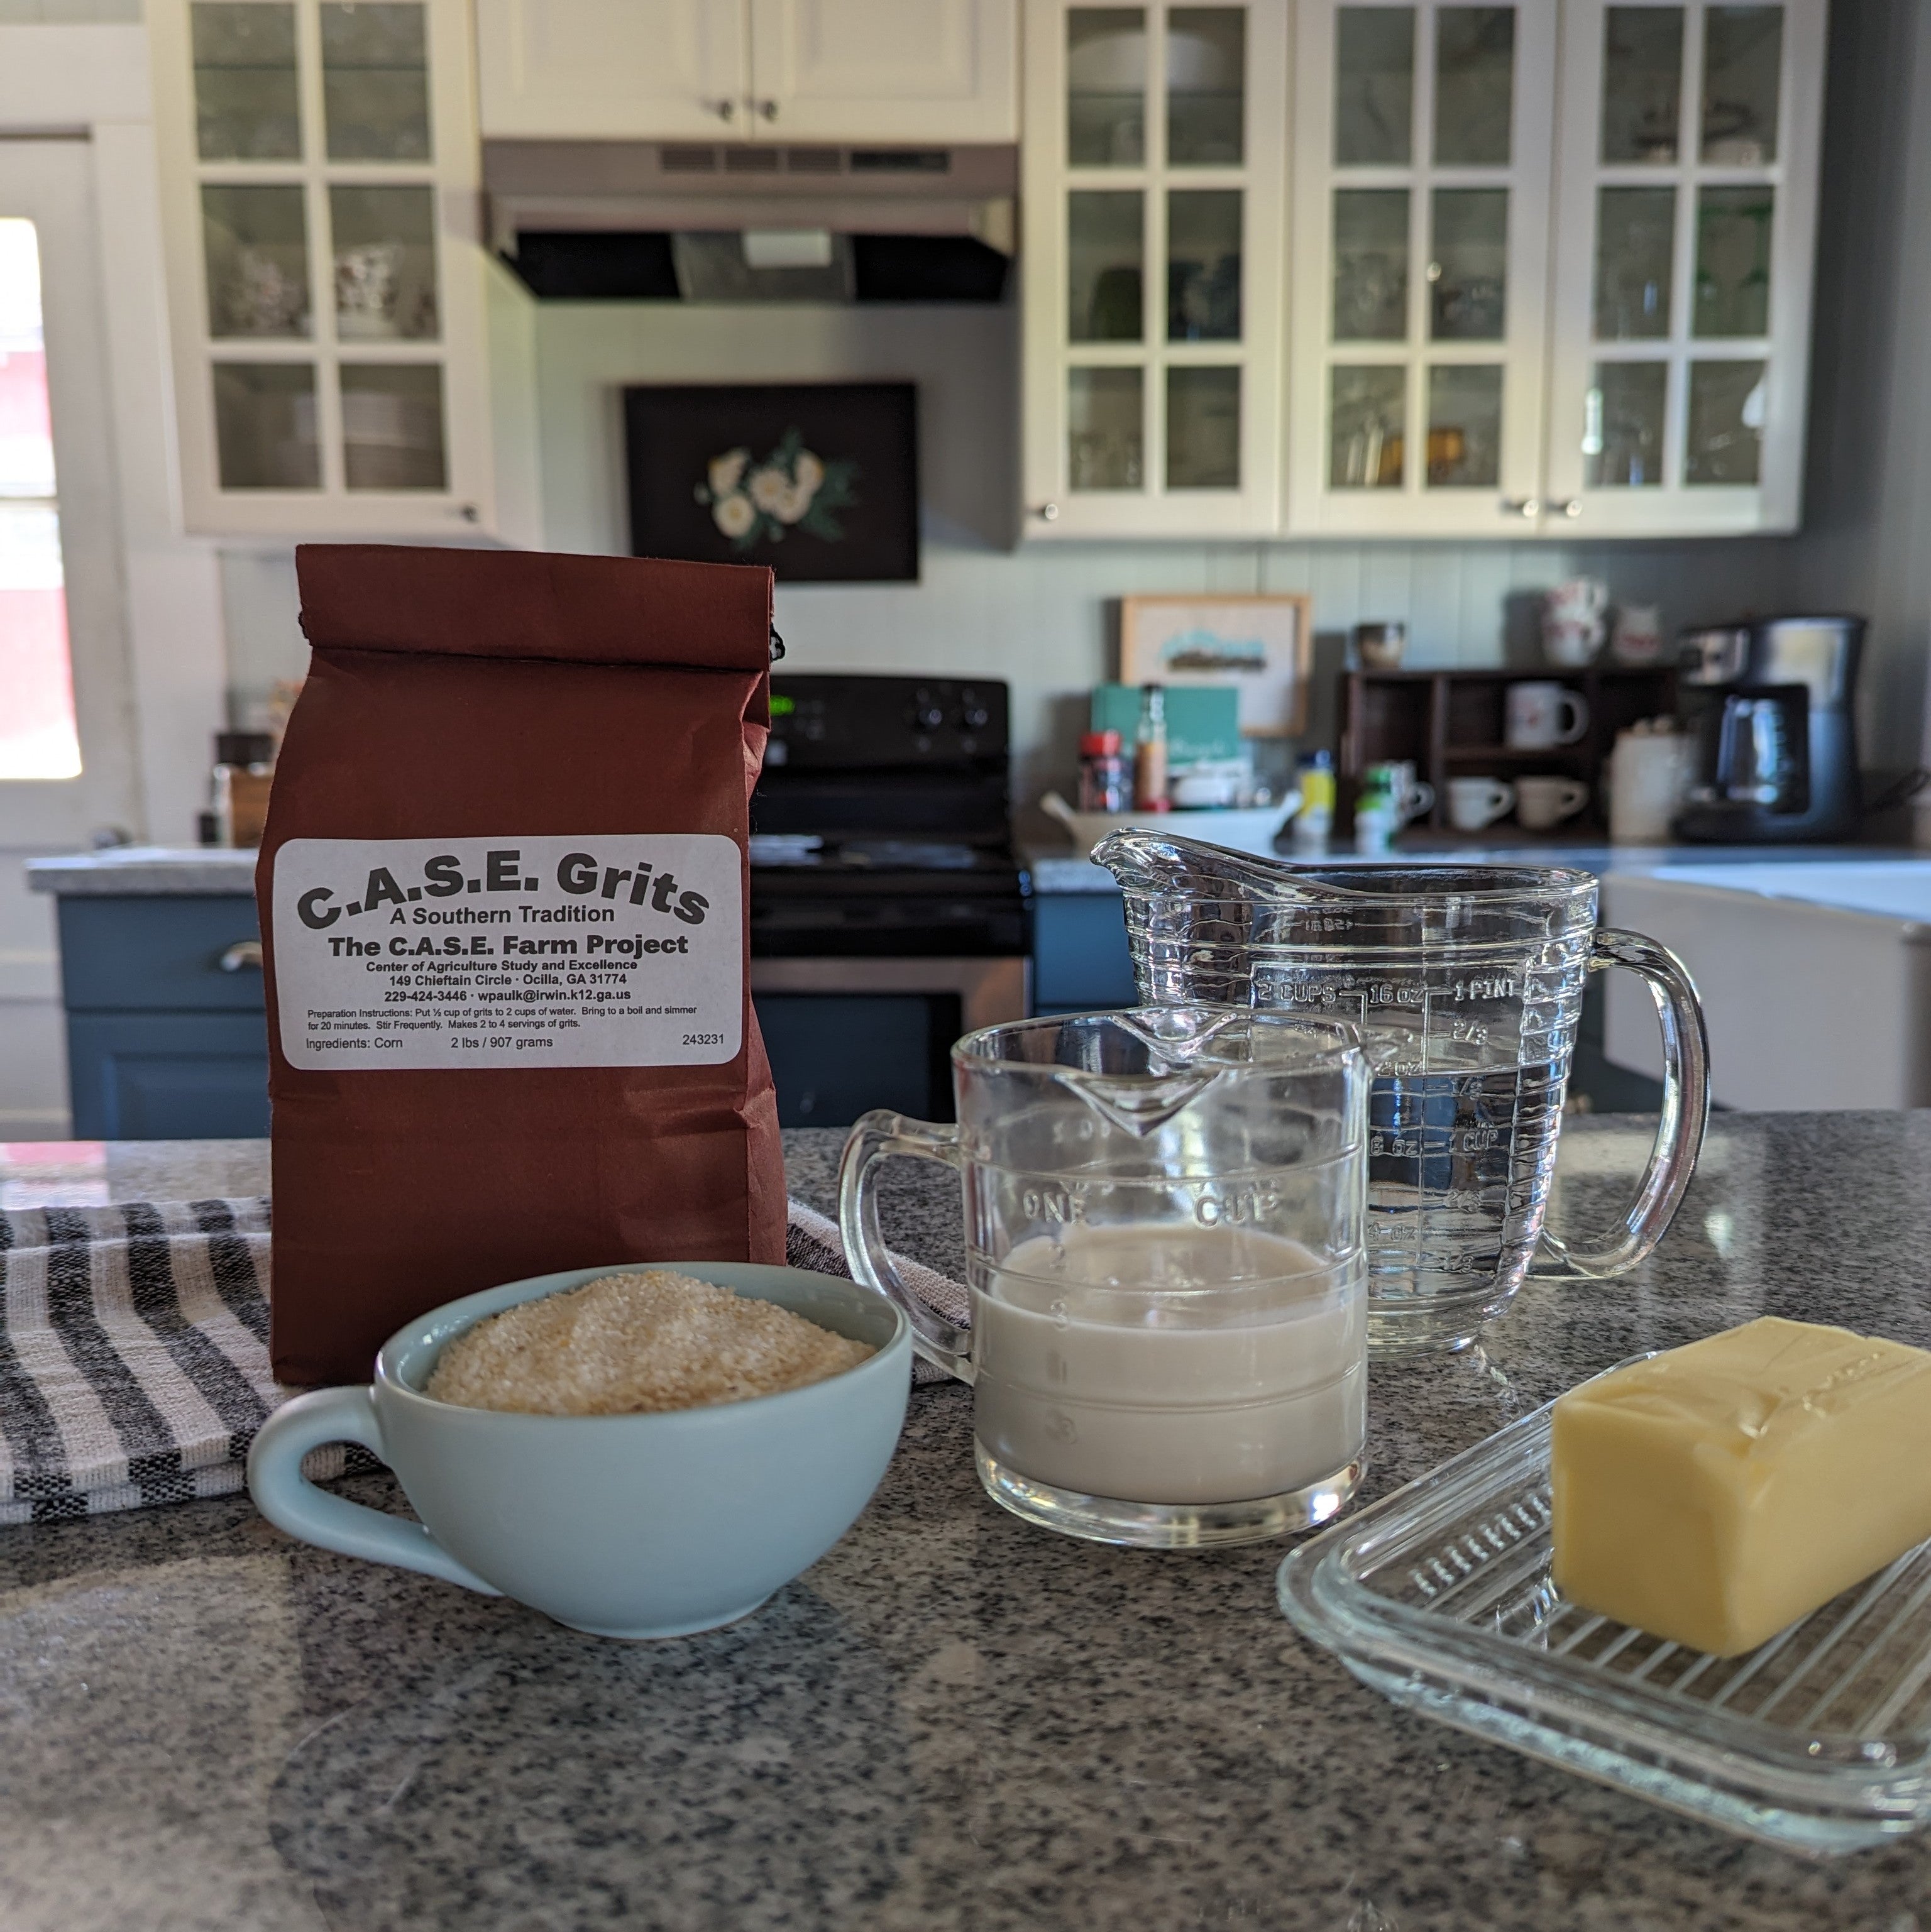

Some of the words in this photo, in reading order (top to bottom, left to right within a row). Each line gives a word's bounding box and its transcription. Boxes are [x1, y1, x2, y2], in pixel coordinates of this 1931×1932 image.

[297, 850, 539, 930] C.A.S.E.
[557, 852, 710, 925] Grits
[390, 908, 406, 924] A
[413, 907, 510, 924] Southern
[519, 905, 614, 922] Tradition
[328, 937, 381, 956] The
[389, 936, 493, 956] C.A.S.E.
[503, 936, 577, 954] Farm
[587, 934, 688, 959] Project
[366, 962, 408, 972] Center
[412, 961, 425, 971] of
[427, 961, 497, 973] Agriculture
[502, 960, 537, 972] Study
[542, 960, 564, 970] and
[569, 960, 637, 970] Excellence
[390, 975, 411, 986] 149
[415, 975, 471, 985] Chieftain
[475, 974, 512, 985] Circle
[524, 974, 562, 986] Ocilla,
[567, 974, 586, 984] GA
[590, 974, 627, 984] 31774
[385, 991, 466, 1002] 229-424-3446
[478, 989, 630, 1003] wpaulk@irwin.k12.ga.us
[1258, 984, 1271, 1001] 2
[1280, 984, 1336, 1004] CUPS
[1370, 984, 1390, 1004] 16
[1455, 980, 1464, 1001] 1
[1470, 978, 1516, 1000] PINT
[308, 1009, 356, 1019] Preparation
[360, 1009, 412, 1017] Instructions:
[444, 1010, 459, 1018] cup
[474, 1008, 492, 1018] grits
[507, 1007, 512, 1016] 2
[582, 1007, 605, 1016] Bring
[627, 1006, 642, 1014] boil
[646, 1006, 662, 1014] and
[664, 1006, 697, 1014] simmer
[308, 1022, 319, 1030] for
[321, 1021, 331, 1029] 20
[334, 1021, 370, 1029] minutes.
[377, 1021, 391, 1029] Stir
[394, 1020, 443, 1031] Frequently.
[448, 1020, 478, 1028] Makes
[480, 1020, 486, 1028] 2
[508, 1019, 545, 1029] servings
[548, 1019, 557, 1027] of
[559, 1019, 580, 1029] grits.
[306, 1038, 370, 1051] Ingredients:
[375, 1038, 402, 1048] Corn
[451, 1038, 458, 1048] 2
[462, 1037, 479, 1048] lbs
[483, 1037, 487, 1048] /
[490, 1036, 512, 1048] 907
[516, 1039, 553, 1050] grams
[683, 1034, 723, 1045] 243231
[1463, 1129, 1499, 1153] CUP
[1023, 1188, 1086, 1226] ONE
[1194, 1192, 1279, 1229] CUP
